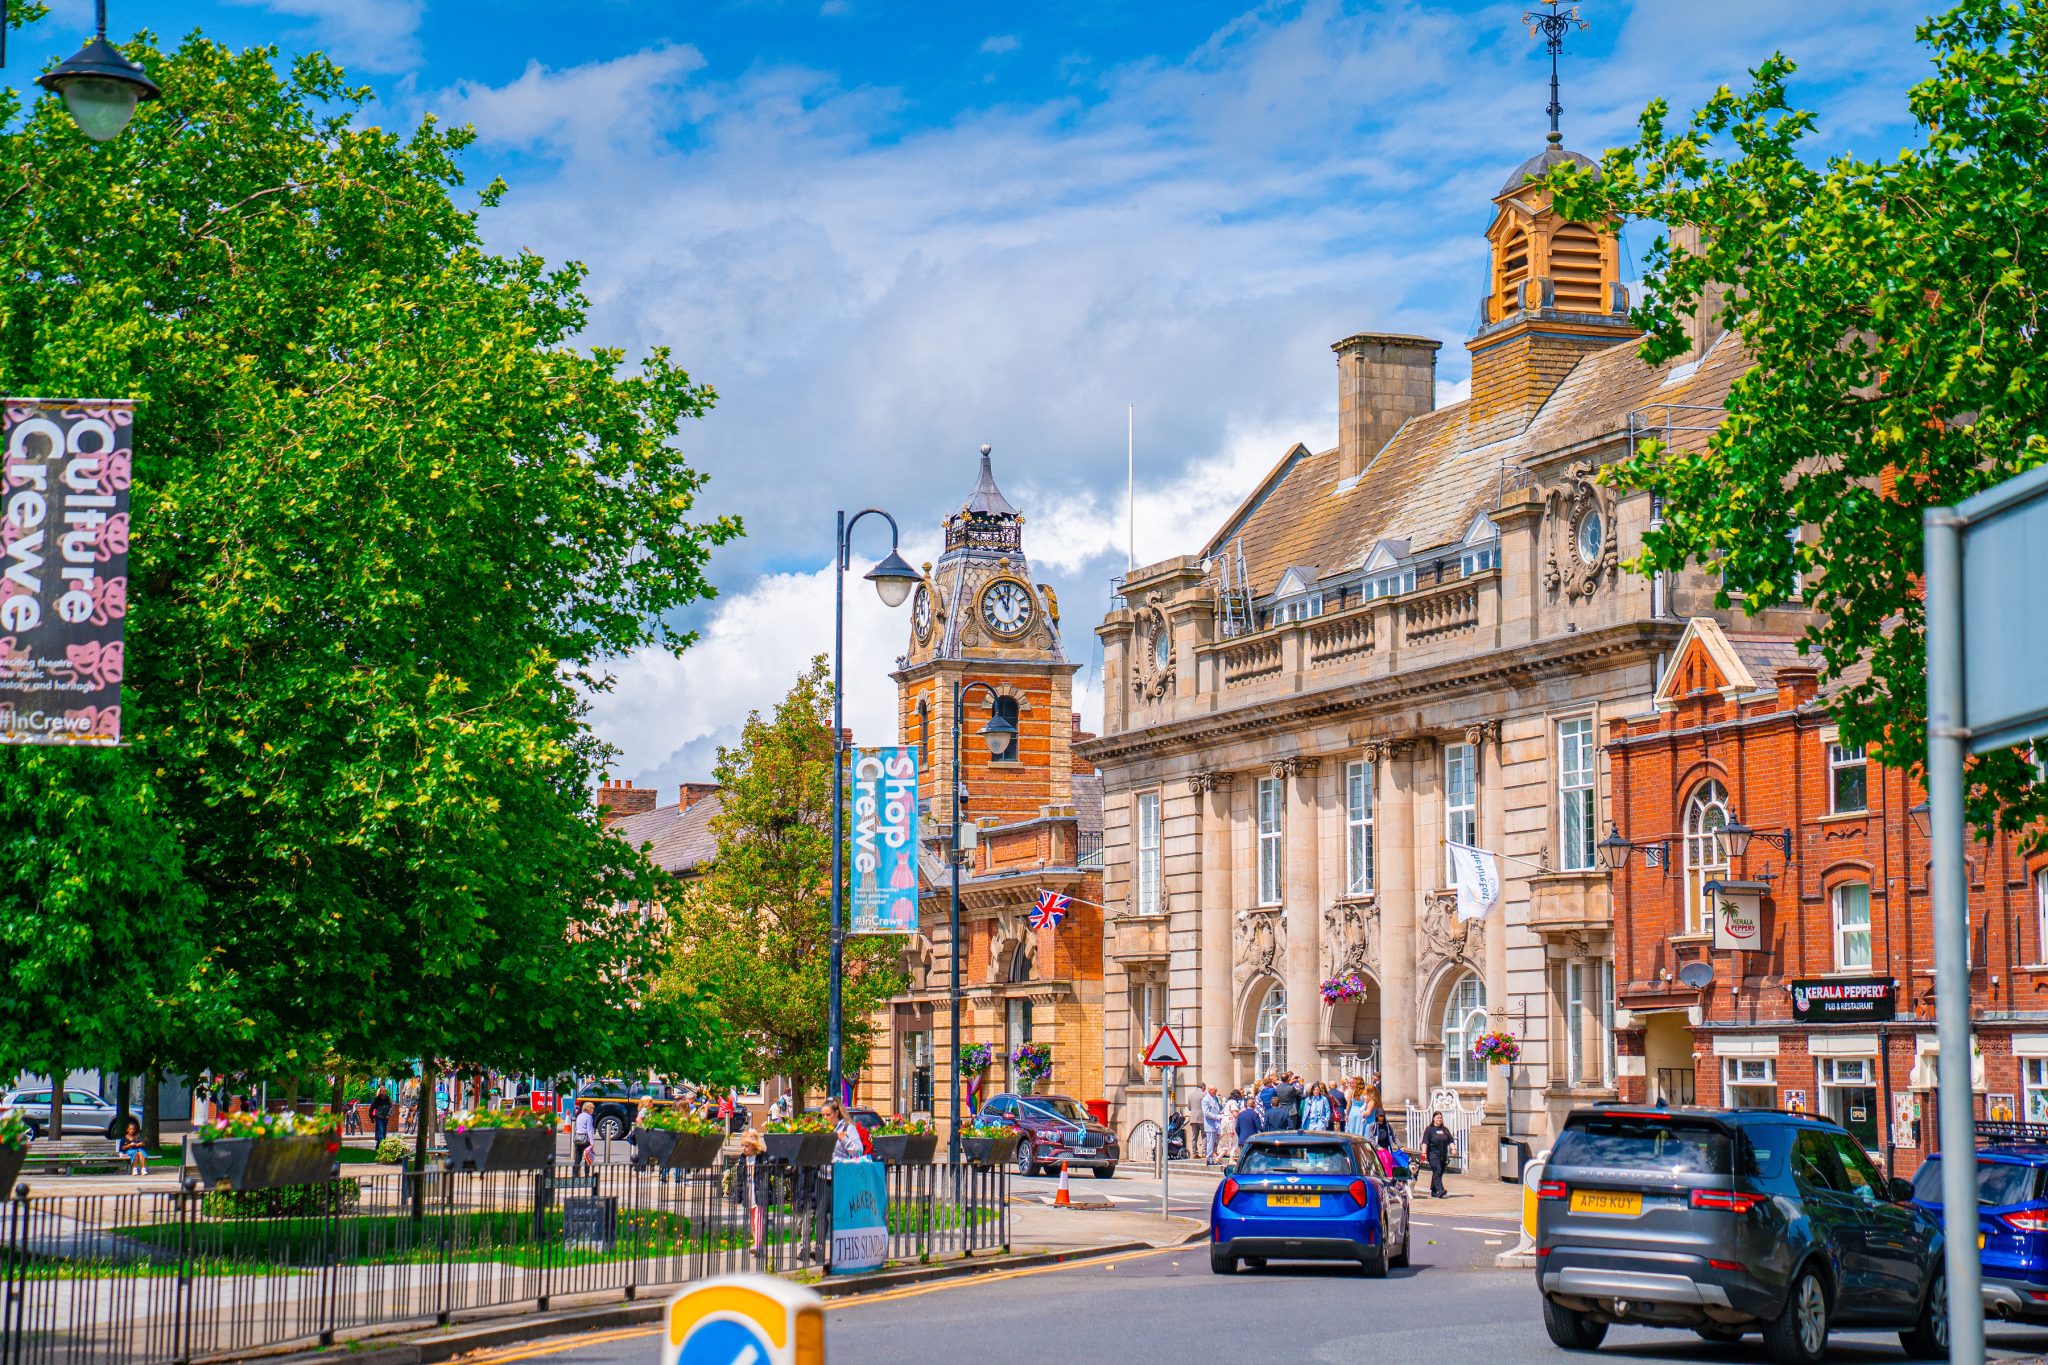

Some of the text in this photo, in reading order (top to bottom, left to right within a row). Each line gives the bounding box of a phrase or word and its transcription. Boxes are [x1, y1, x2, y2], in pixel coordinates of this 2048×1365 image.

[1, 418, 66, 632] Crewe
[59, 418, 116, 623] Culture
[37, 657, 73, 669] theatre
[0, 669, 44, 679] ive music
[33, 680, 52, 690] and
[54, 680, 96, 693] heritage
[0, 710, 91, 731] #InCrewe
[877, 756, 916, 848] Shop
[855, 757, 885, 873] Crewe
[855, 915, 904, 926] #InCrewe
[1805, 985, 1886, 999] KERALA PEPPERY
[1825, 1002, 1836, 1011] PUB
[1840, 1002, 1874, 1010] RESTAURANT
[849, 1189, 877, 1218] MAKERS
[1580, 1195, 1634, 1209] AP19 KUY
[836, 1234, 887, 1261] THIS SUNDAY
